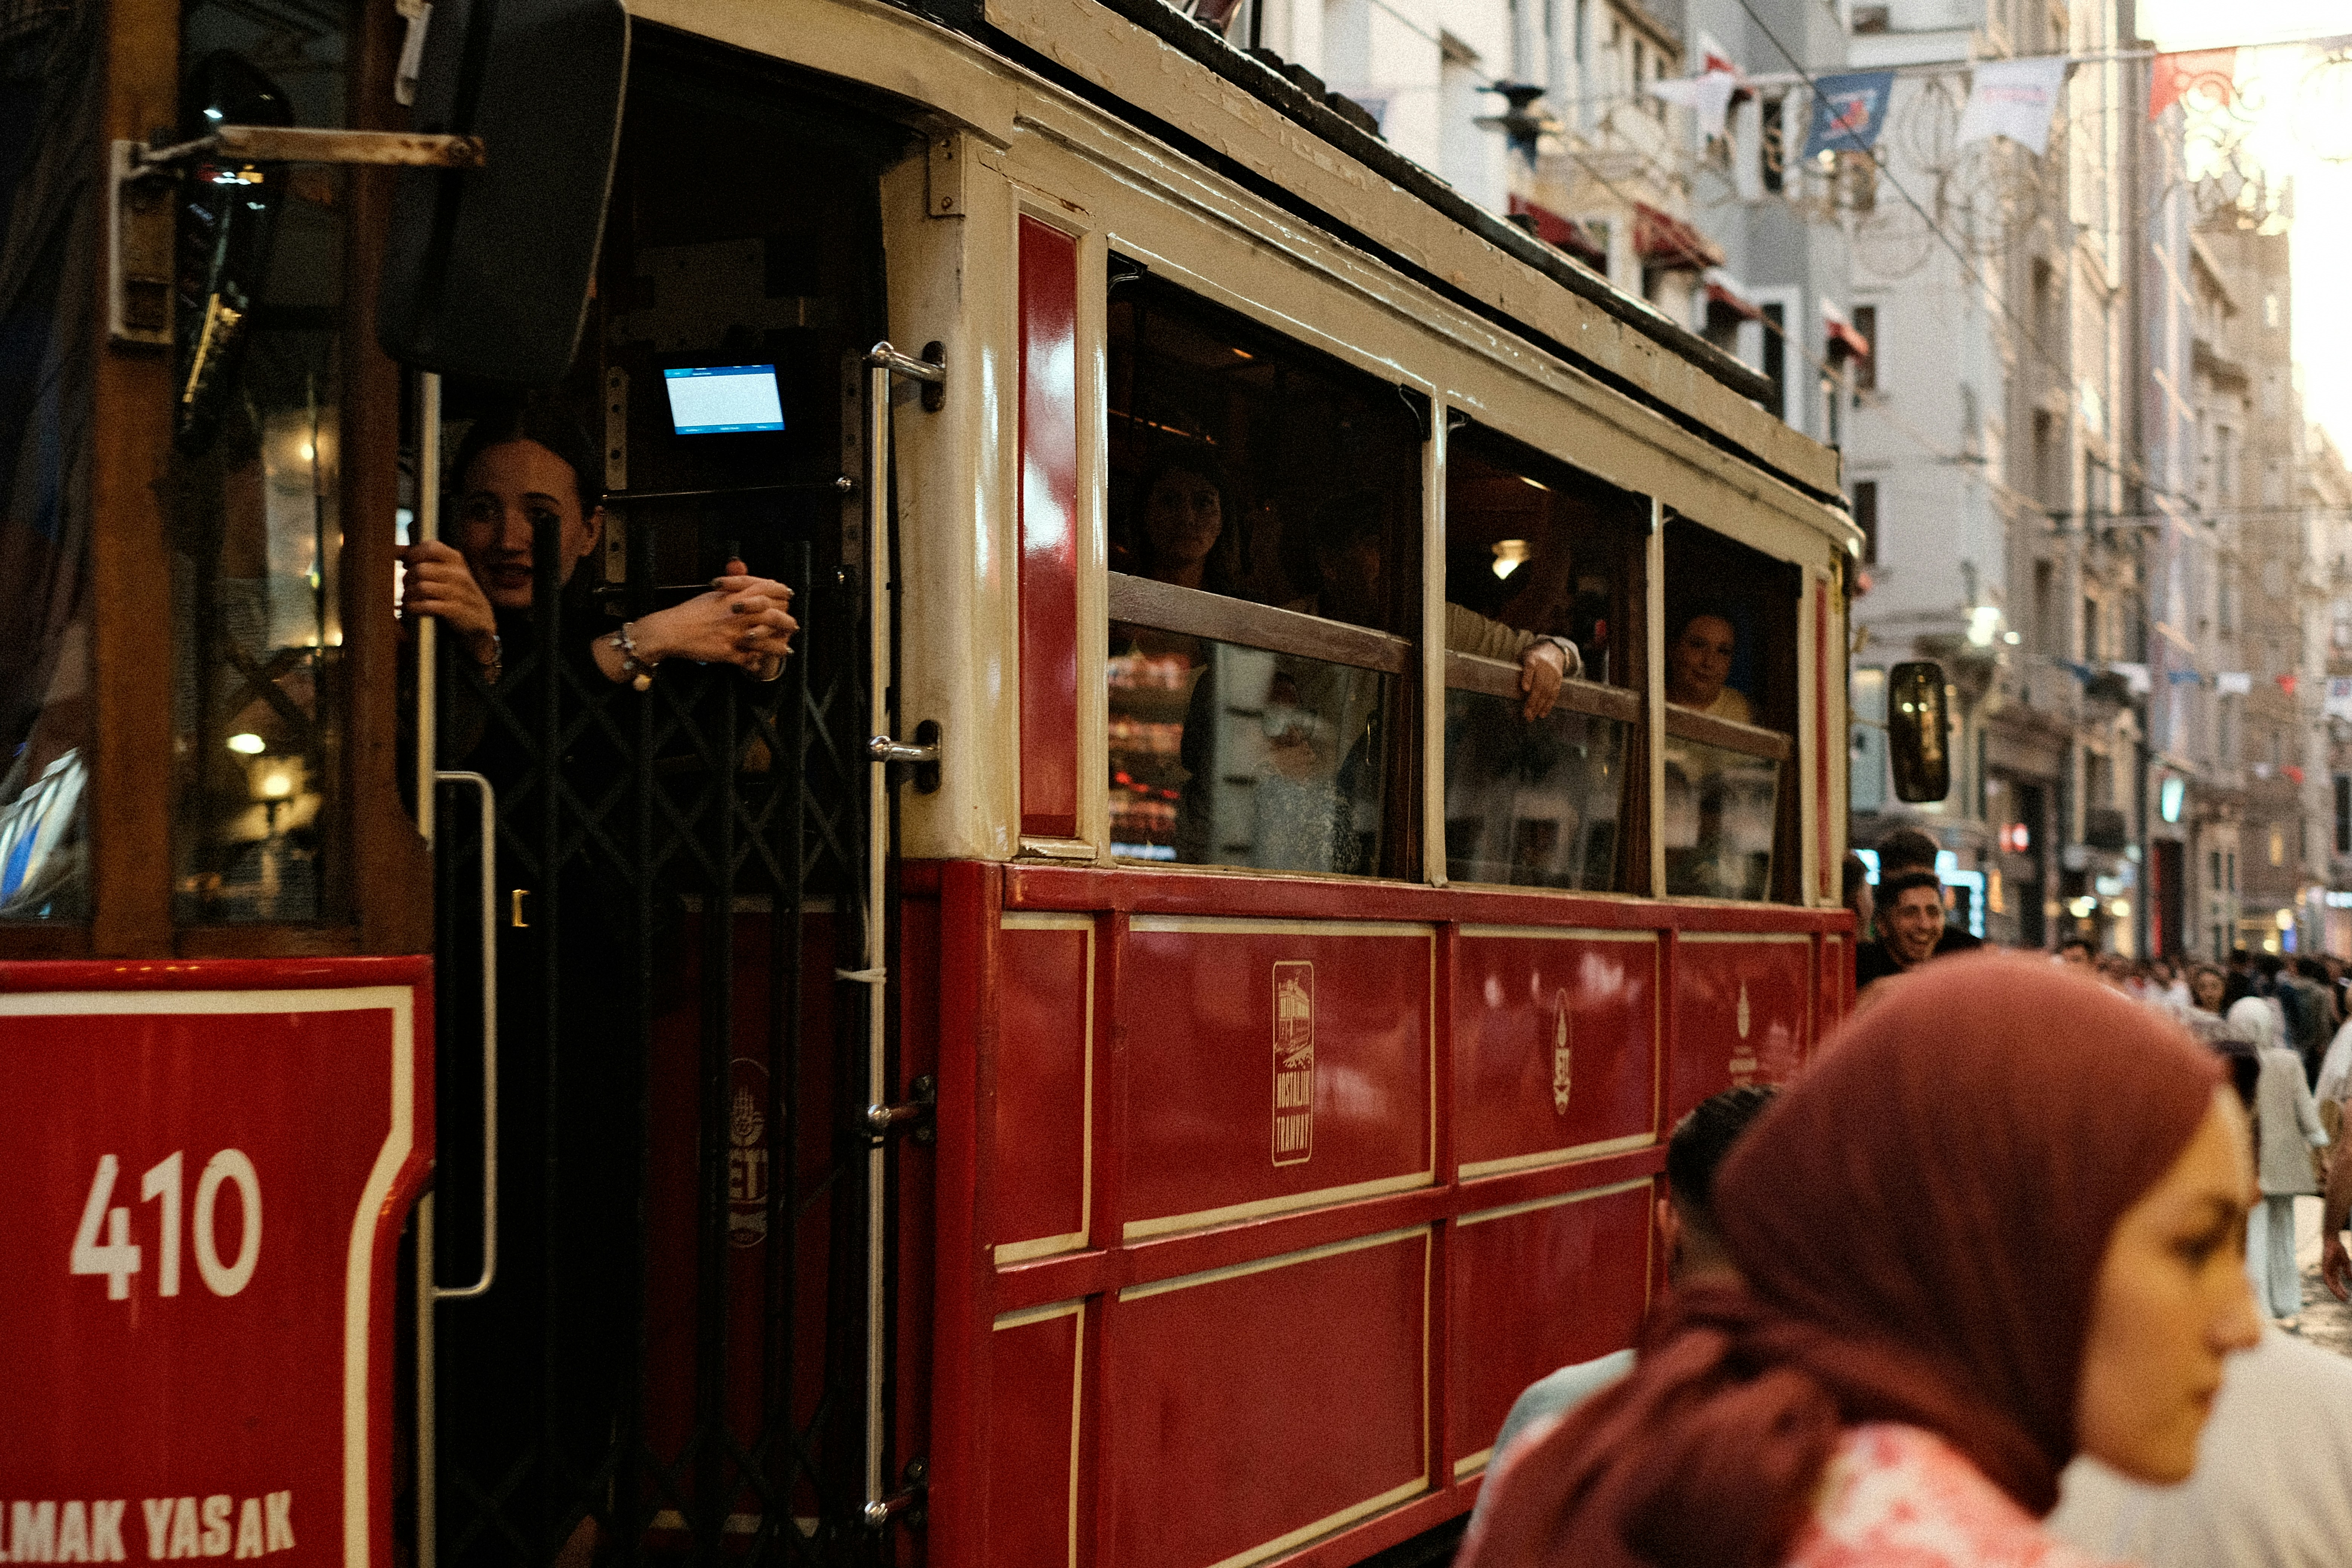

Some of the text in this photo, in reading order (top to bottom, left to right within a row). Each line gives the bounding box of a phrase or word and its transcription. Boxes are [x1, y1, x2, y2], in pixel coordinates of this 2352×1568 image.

[1277, 1114, 1309, 1152] TRAMVAY
[70, 1148, 263, 1300] 410
[142, 1490, 296, 1561] YASAK
